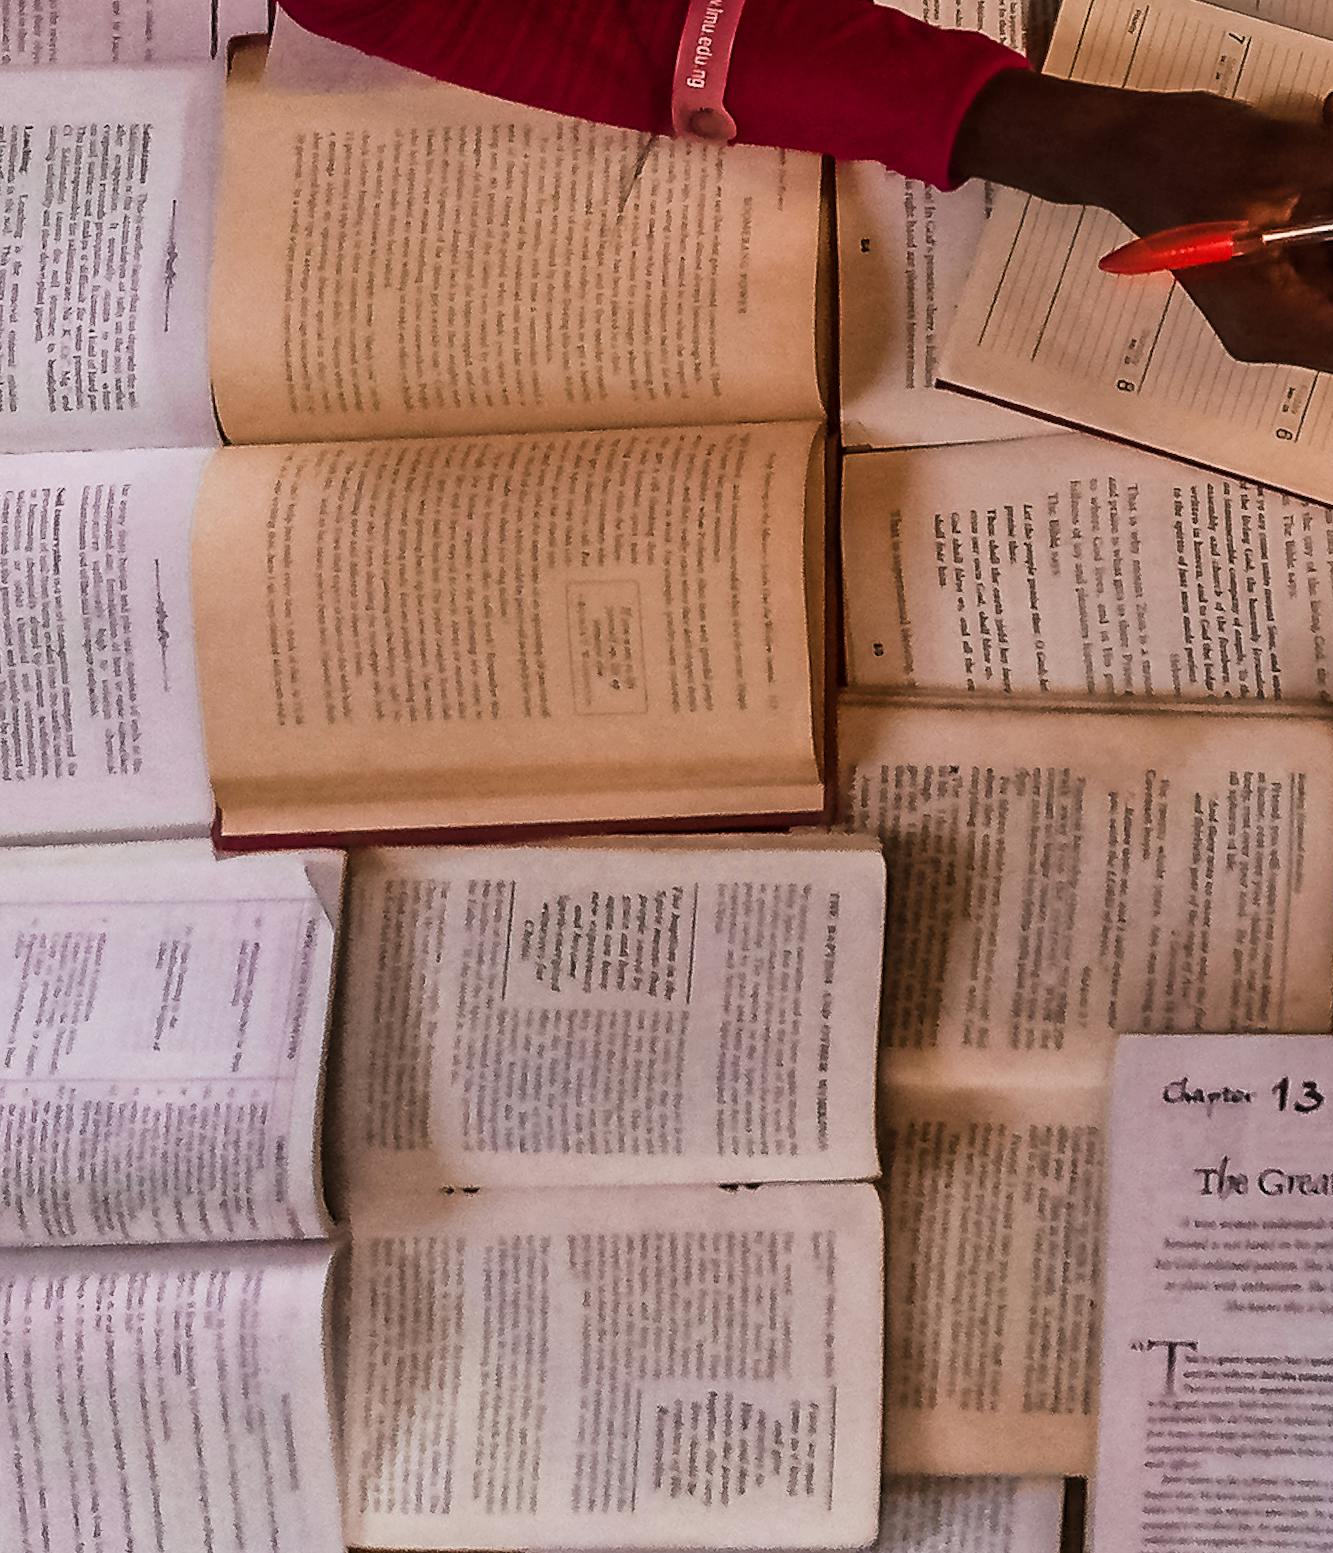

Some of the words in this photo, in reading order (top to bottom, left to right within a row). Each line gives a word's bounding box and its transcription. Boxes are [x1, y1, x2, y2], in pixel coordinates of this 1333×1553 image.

[1228, 31, 1246, 45] 7
[1116, 378, 1135, 394] 8
[1275, 427, 1294, 442] 6
[1162, 1076, 1257, 1119] Chapter
[1271, 1076, 1326, 1114] 13
[1193, 1154, 1249, 1201] The
